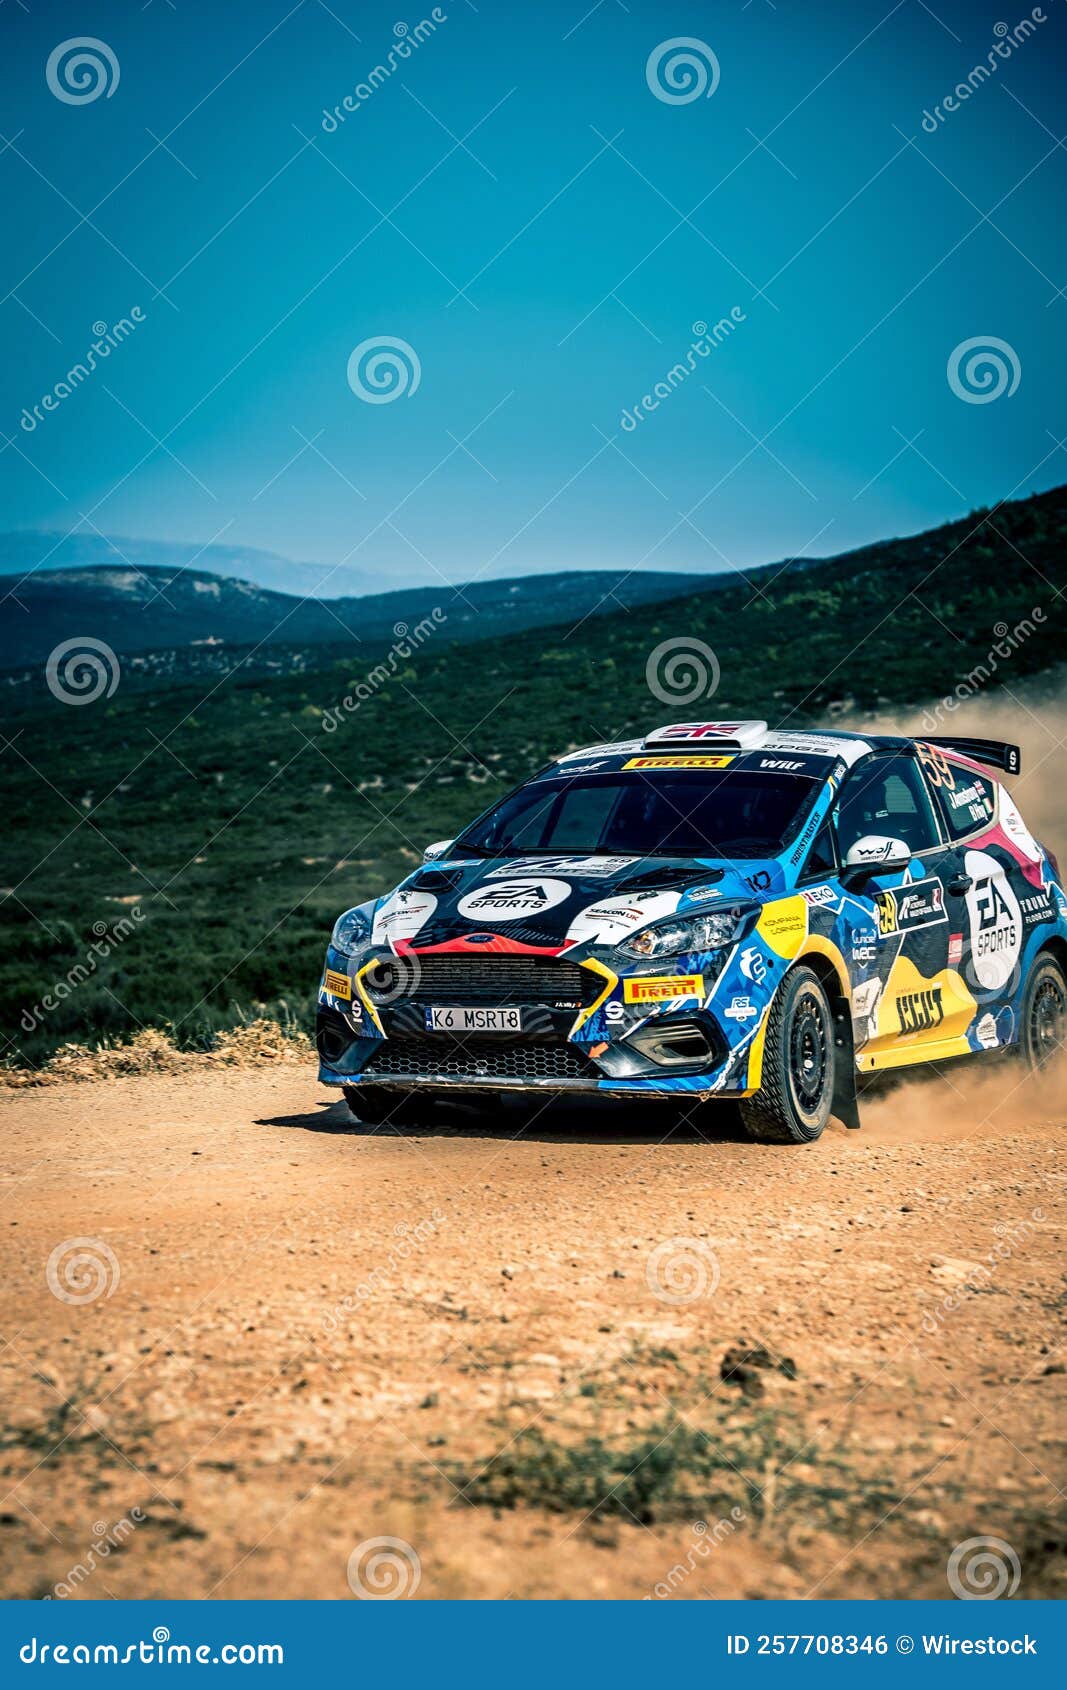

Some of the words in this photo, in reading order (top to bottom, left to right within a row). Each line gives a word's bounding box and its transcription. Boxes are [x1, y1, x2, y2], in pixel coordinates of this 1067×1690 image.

[634, 757, 724, 767] PIRELLI
[477, 885, 549, 900] EA
[811, 886, 835, 902] EKO
[467, 898, 547, 909] SPORTS
[589, 908, 627, 917] SEACON
[977, 925, 1017, 957] SPORTS
[326, 974, 348, 996] PIRELLI
[631, 979, 696, 998] PIRELLI
[434, 1010, 454, 1028] K6
[464, 1010, 519, 1028] MSRT8
